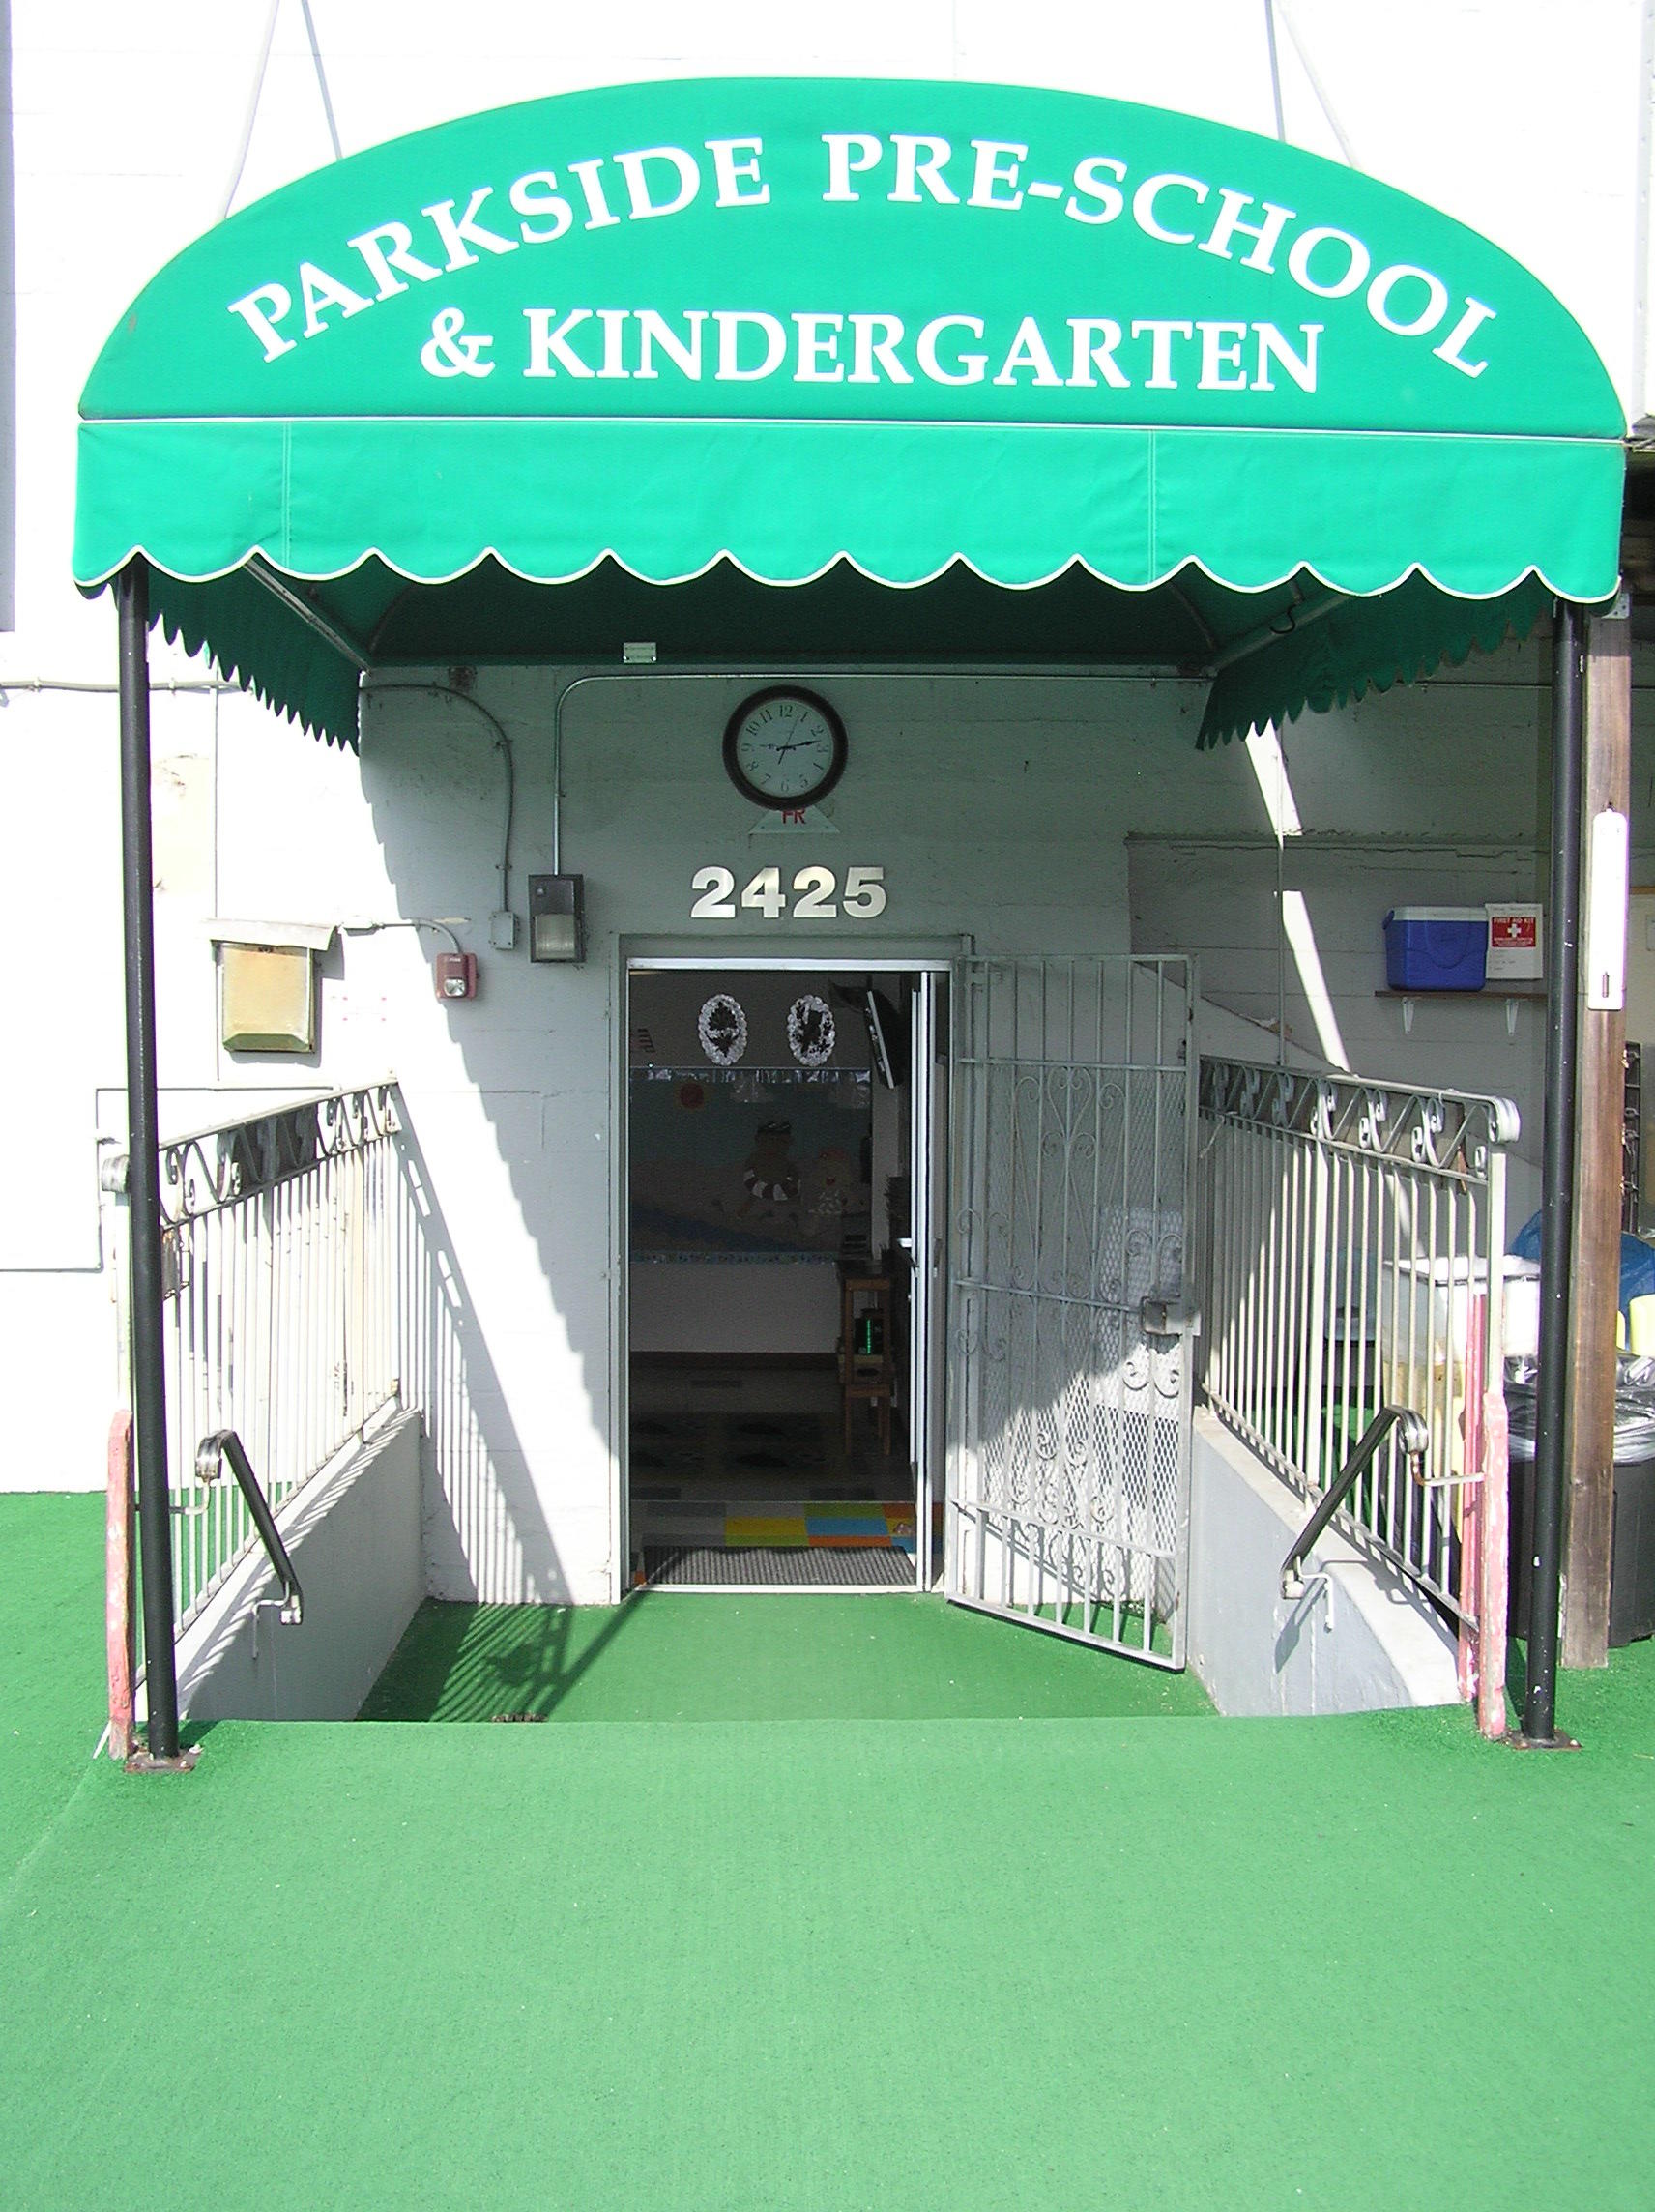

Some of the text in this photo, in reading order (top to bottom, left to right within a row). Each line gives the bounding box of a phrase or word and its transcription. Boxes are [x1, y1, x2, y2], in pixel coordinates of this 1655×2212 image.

[227, 133, 1497, 378] PARKSIDE PRE-SCHOOL
[420, 306, 1325, 393] & KINDERGARTEN
[759, 709, 773, 723] 11
[779, 705, 794, 718] 12
[801, 711, 809, 722] 1
[745, 721, 760, 736] 10
[691, 866, 886, 918] 2425
